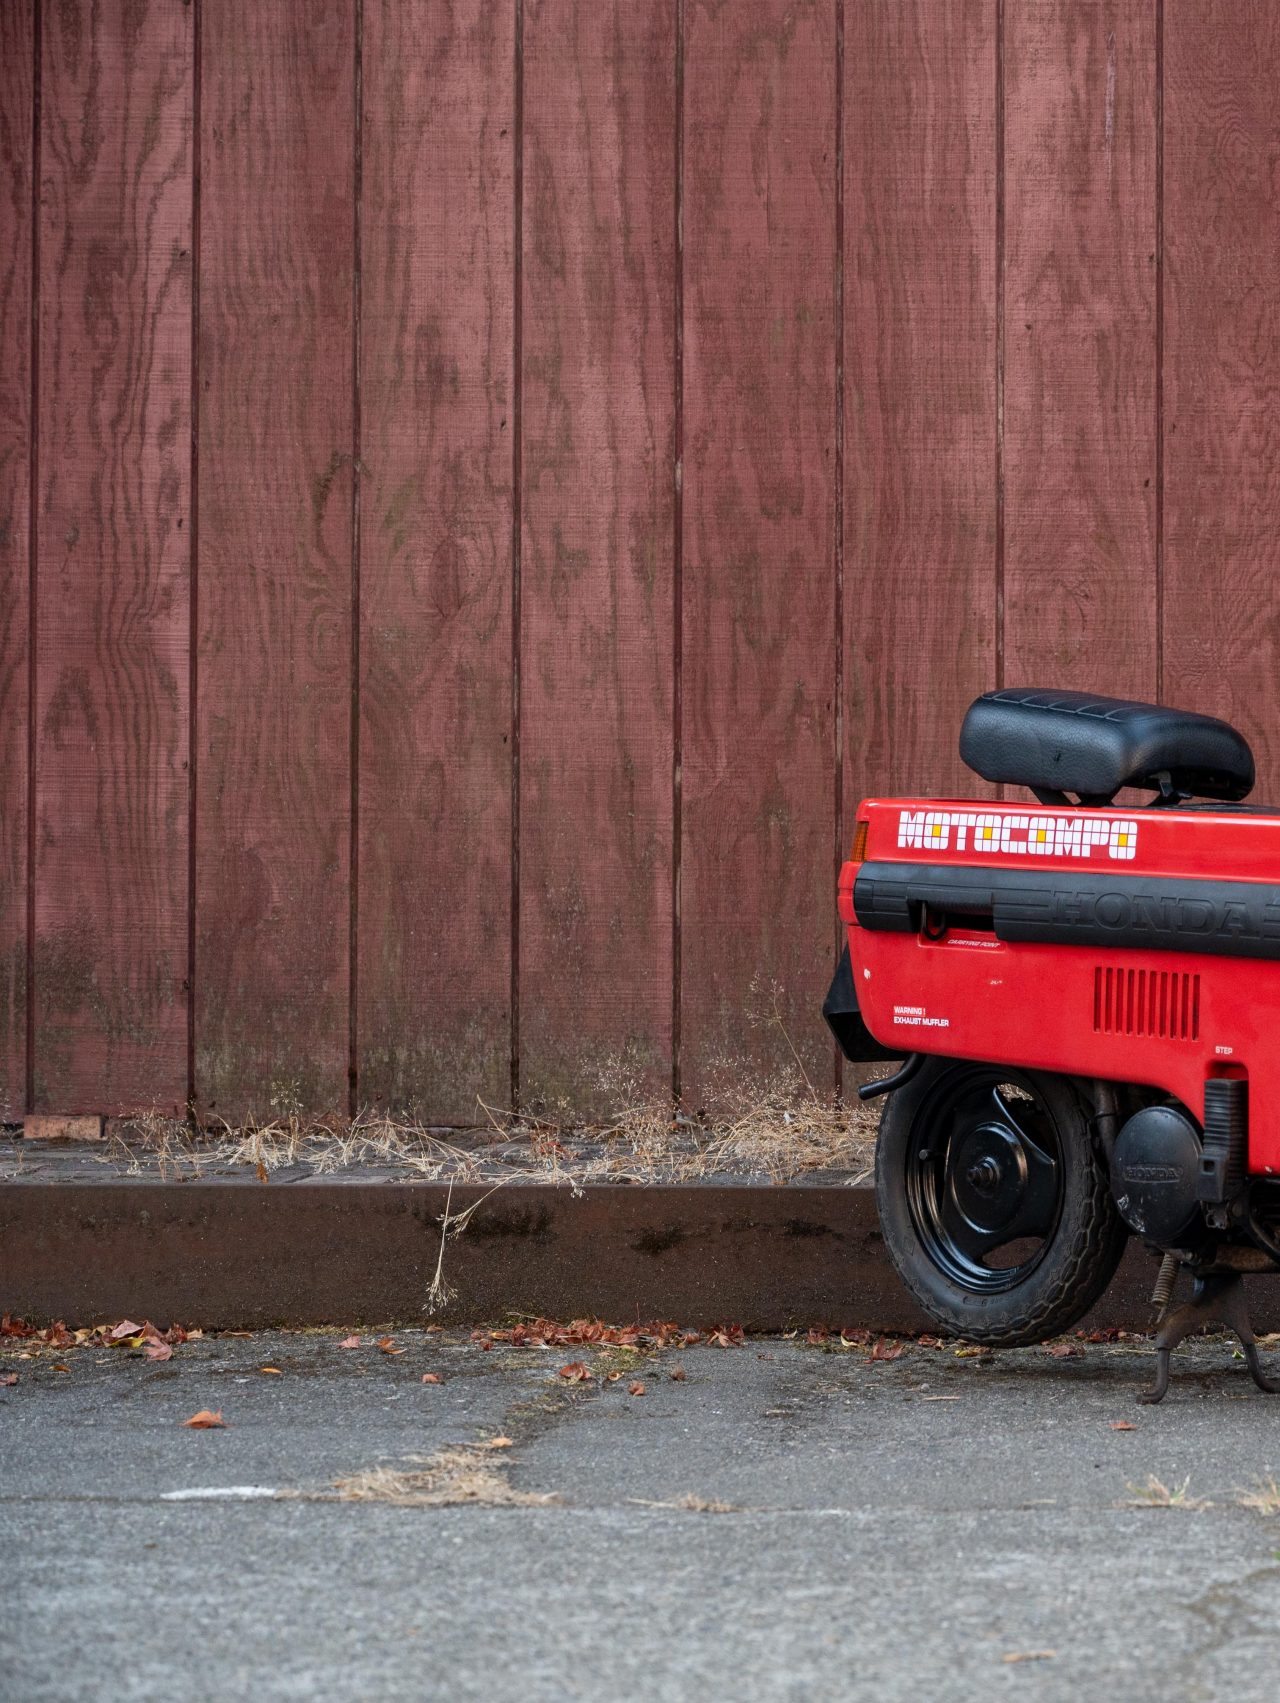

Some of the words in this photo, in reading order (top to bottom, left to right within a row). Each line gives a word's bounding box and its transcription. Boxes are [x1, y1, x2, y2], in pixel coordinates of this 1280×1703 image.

[898, 811, 1138, 860] MOTOCOMPO
[1053, 890, 1261, 940] HONDA
[893, 1016, 921, 1025] EXHAUST
[922, 1017, 949, 1027] MUFFLER
[1215, 1045, 1233, 1055] STEP
[1126, 1167, 1180, 1178] HONDA
